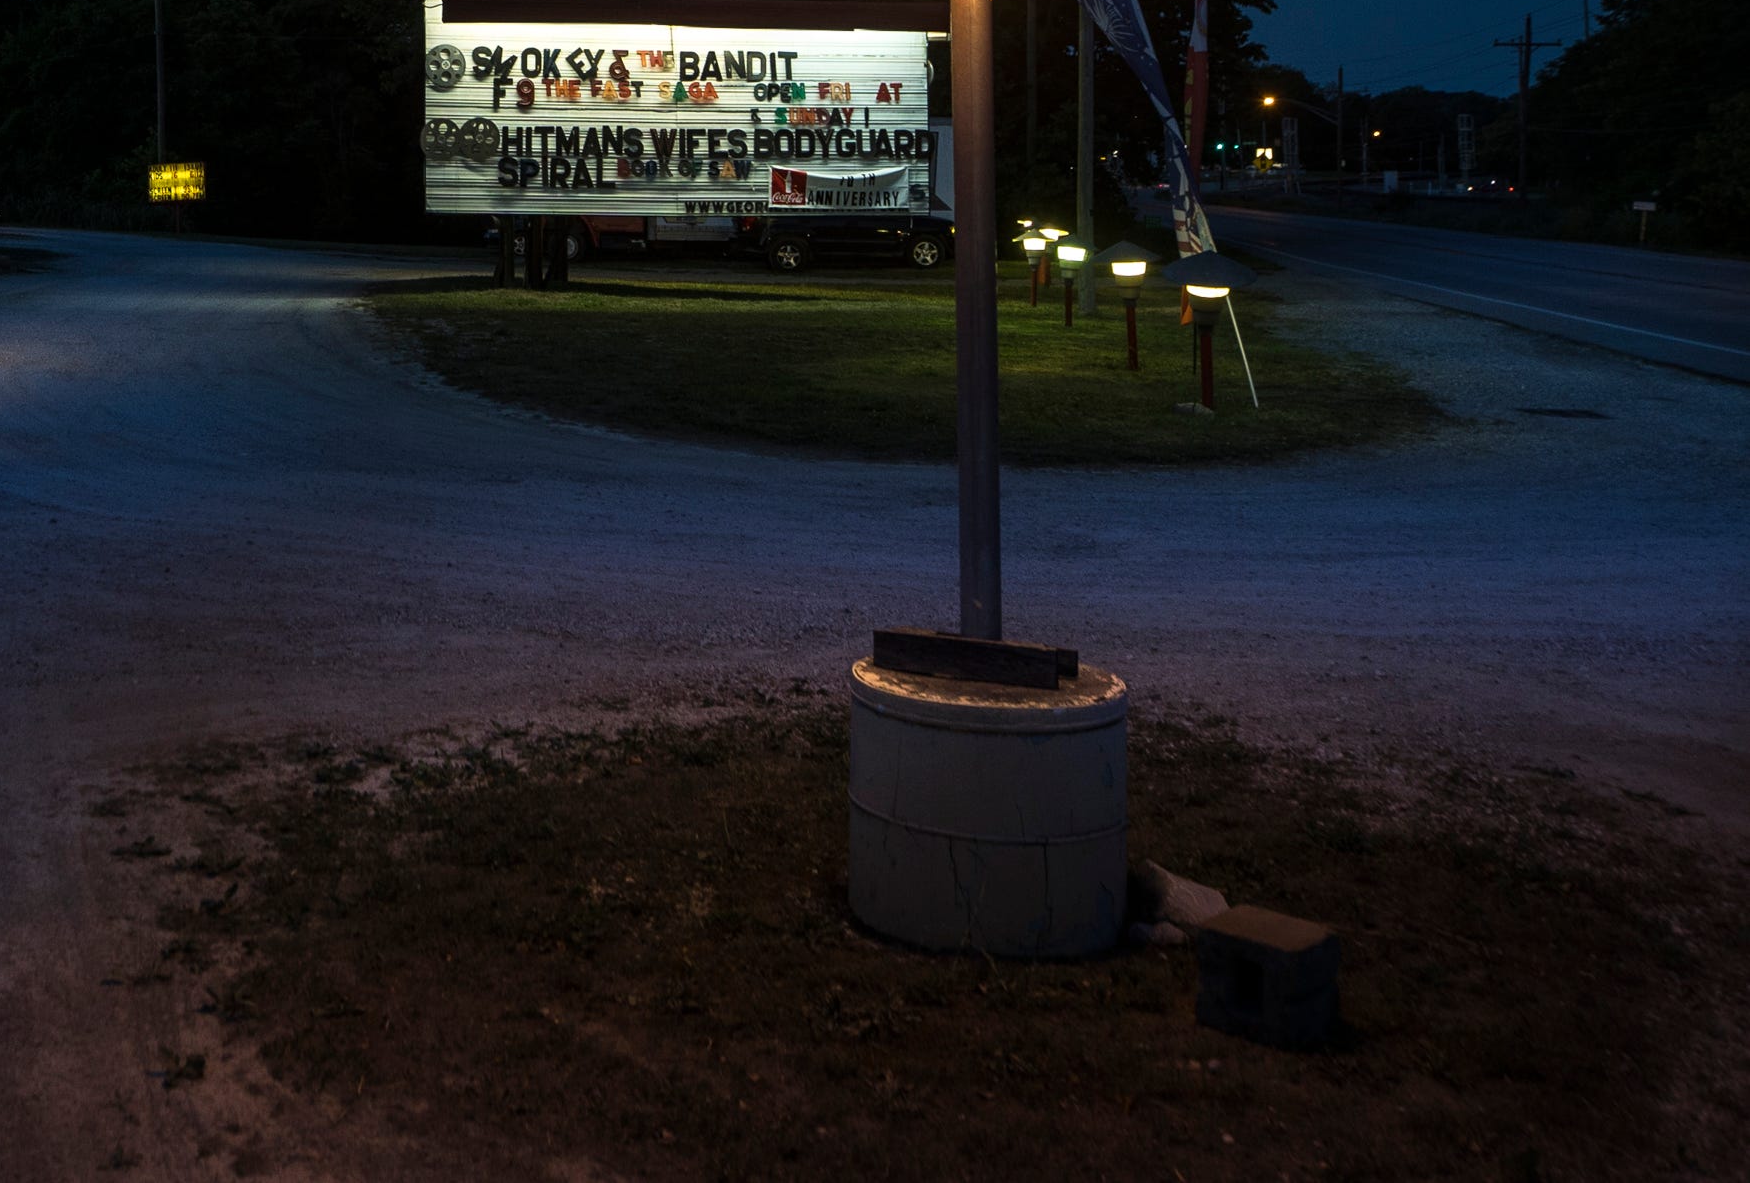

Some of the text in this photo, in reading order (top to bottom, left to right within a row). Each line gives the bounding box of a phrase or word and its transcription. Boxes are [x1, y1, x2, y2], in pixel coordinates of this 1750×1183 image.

[472, 45, 798, 82] SMOKEY & THE BANDIT
[542, 78, 581, 98] THE
[591, 79, 644, 98] FAST
[658, 81, 719, 101] SAGA
[753, 82, 806, 103] OPEN
[818, 82, 851, 102] FRI
[875, 82, 903, 103] AT
[775, 107, 854, 126] SUNDAY
[502, 125, 935, 160] HITMANS WIFES BODYGUARD
[498, 155, 751, 190] SPIRAL BOOK OF SAW
[808, 188, 900, 208] ANNIVERSARY
